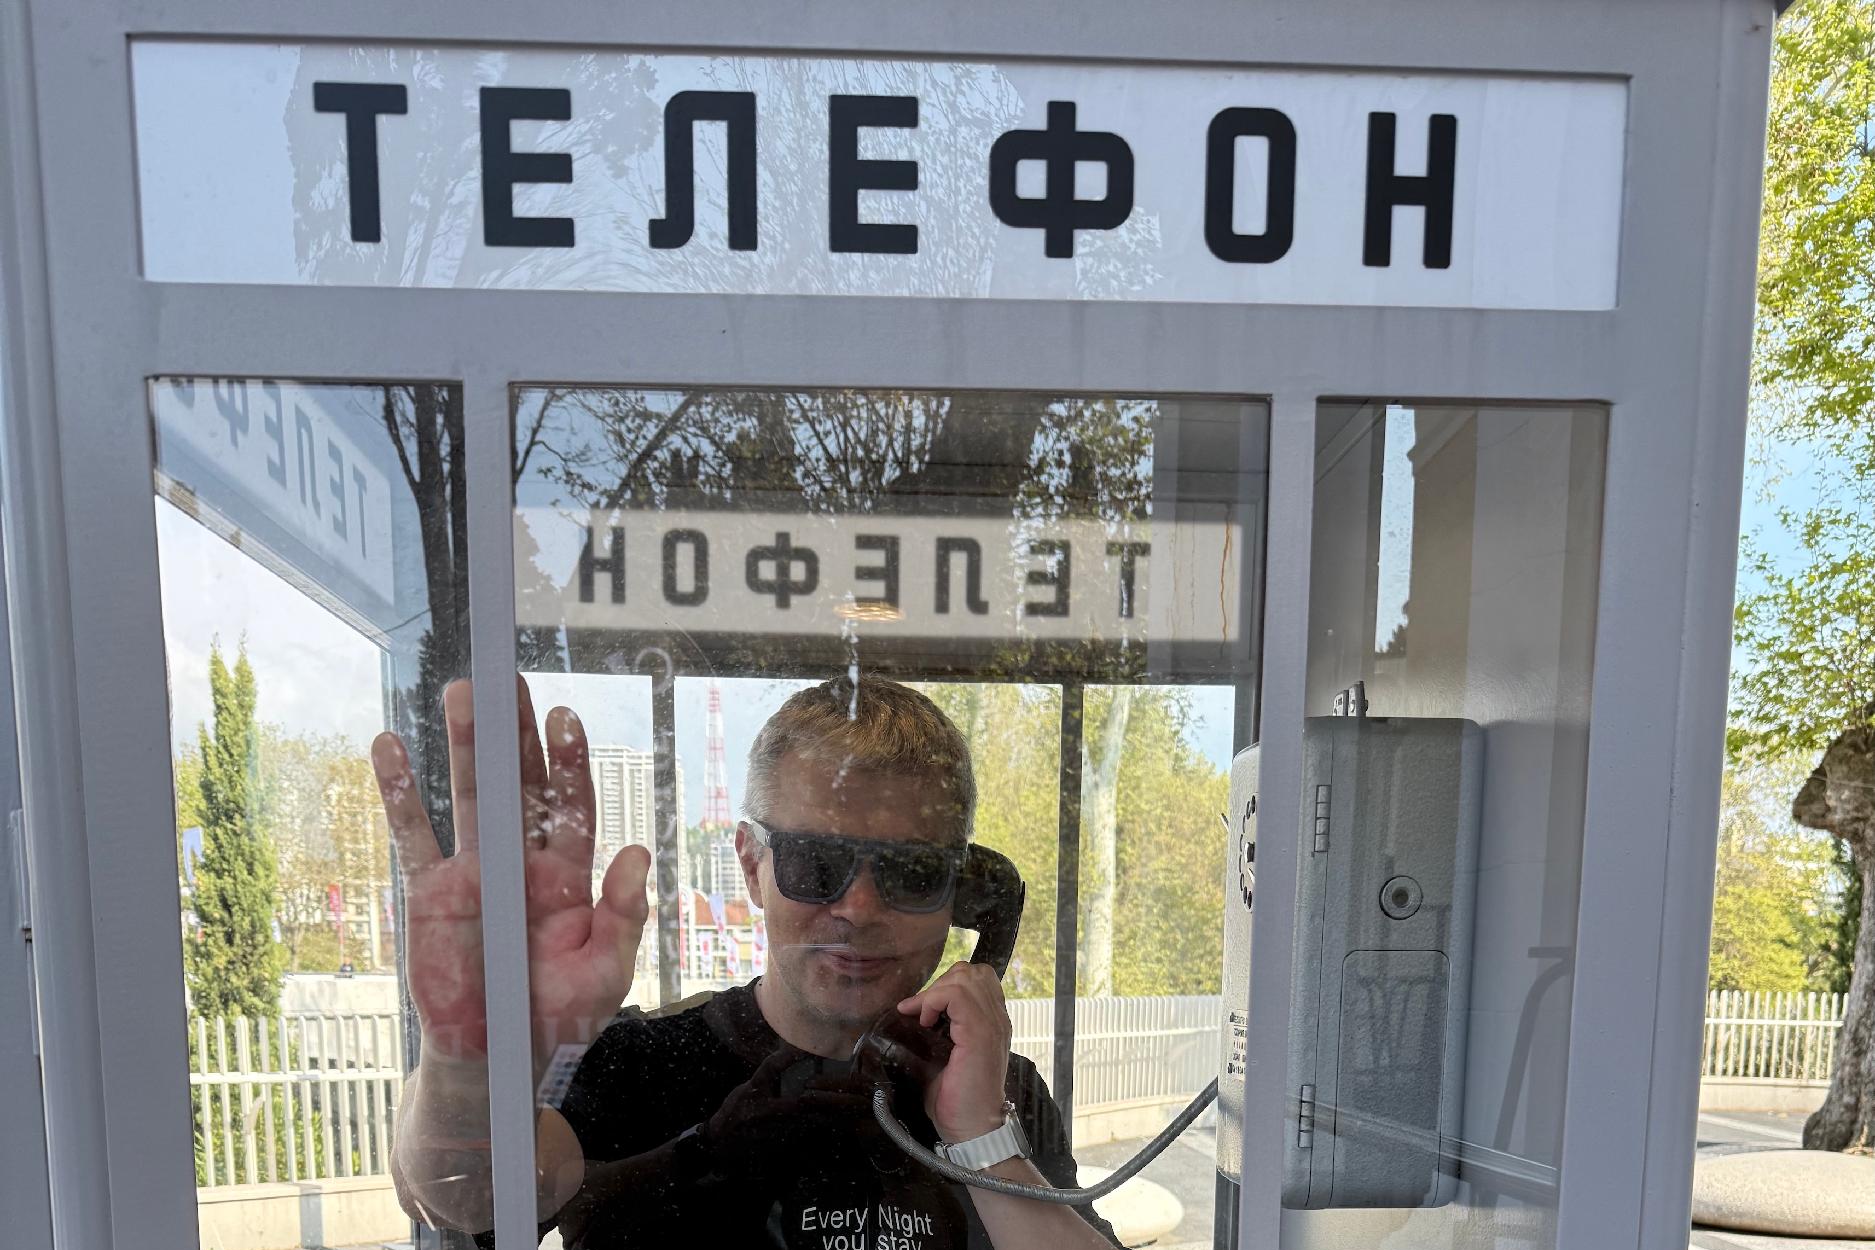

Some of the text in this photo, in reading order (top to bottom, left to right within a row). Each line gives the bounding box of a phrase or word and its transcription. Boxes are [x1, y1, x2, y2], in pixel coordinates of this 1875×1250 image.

[312, 81, 1458, 269] ТЕЛЕФОН
[801, 1203, 934, 1238] Every Night
